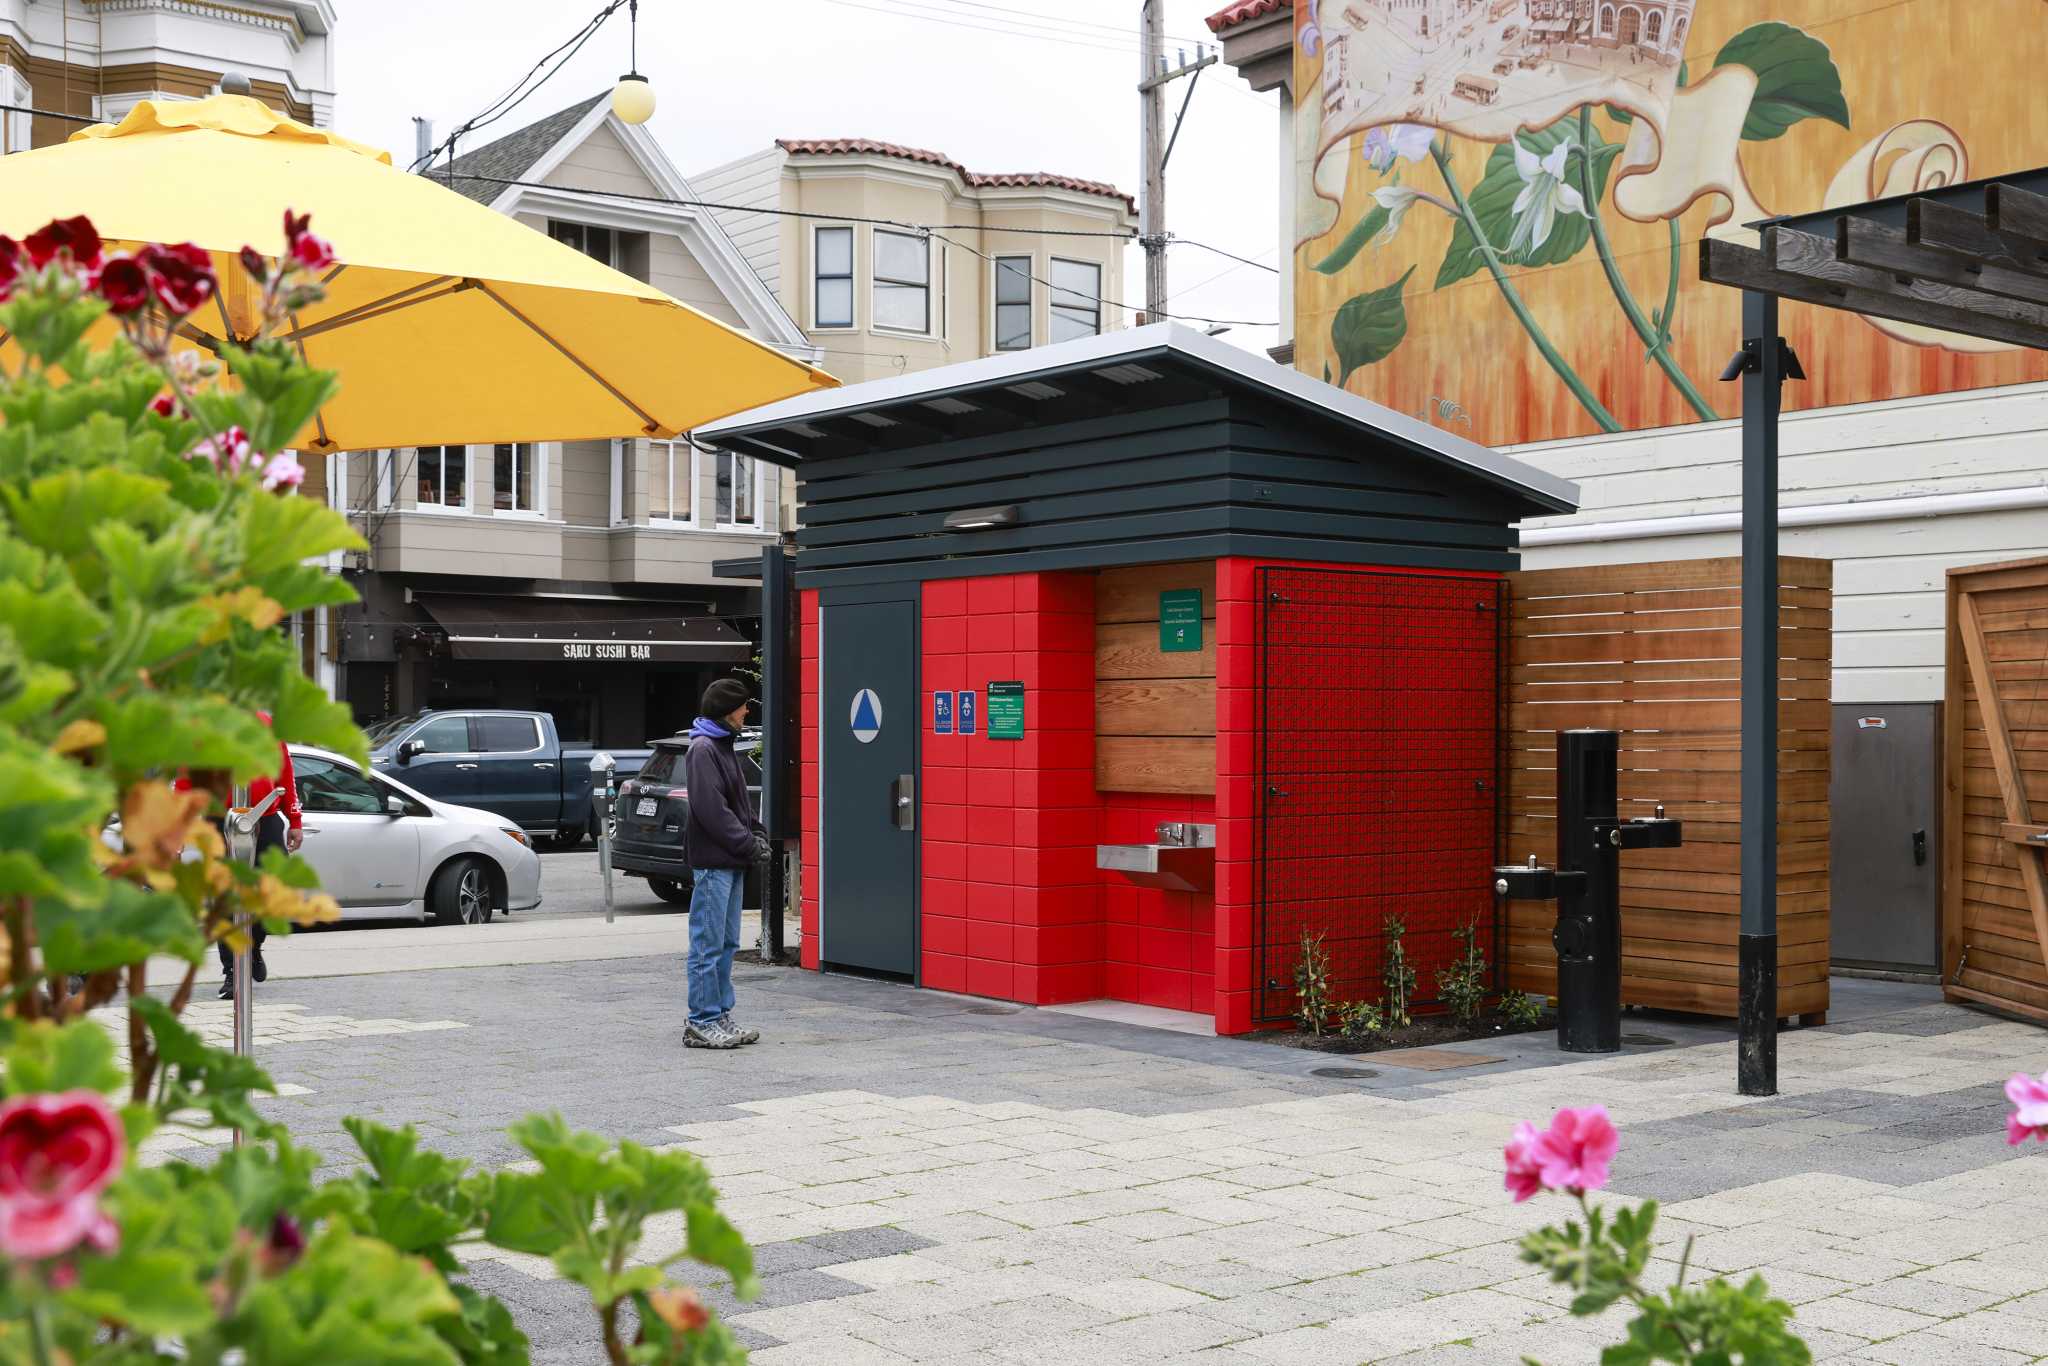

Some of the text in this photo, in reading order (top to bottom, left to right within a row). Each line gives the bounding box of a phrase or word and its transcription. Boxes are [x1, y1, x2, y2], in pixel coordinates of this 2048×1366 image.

[563, 644, 650, 659] SARU SUSHI BAR
